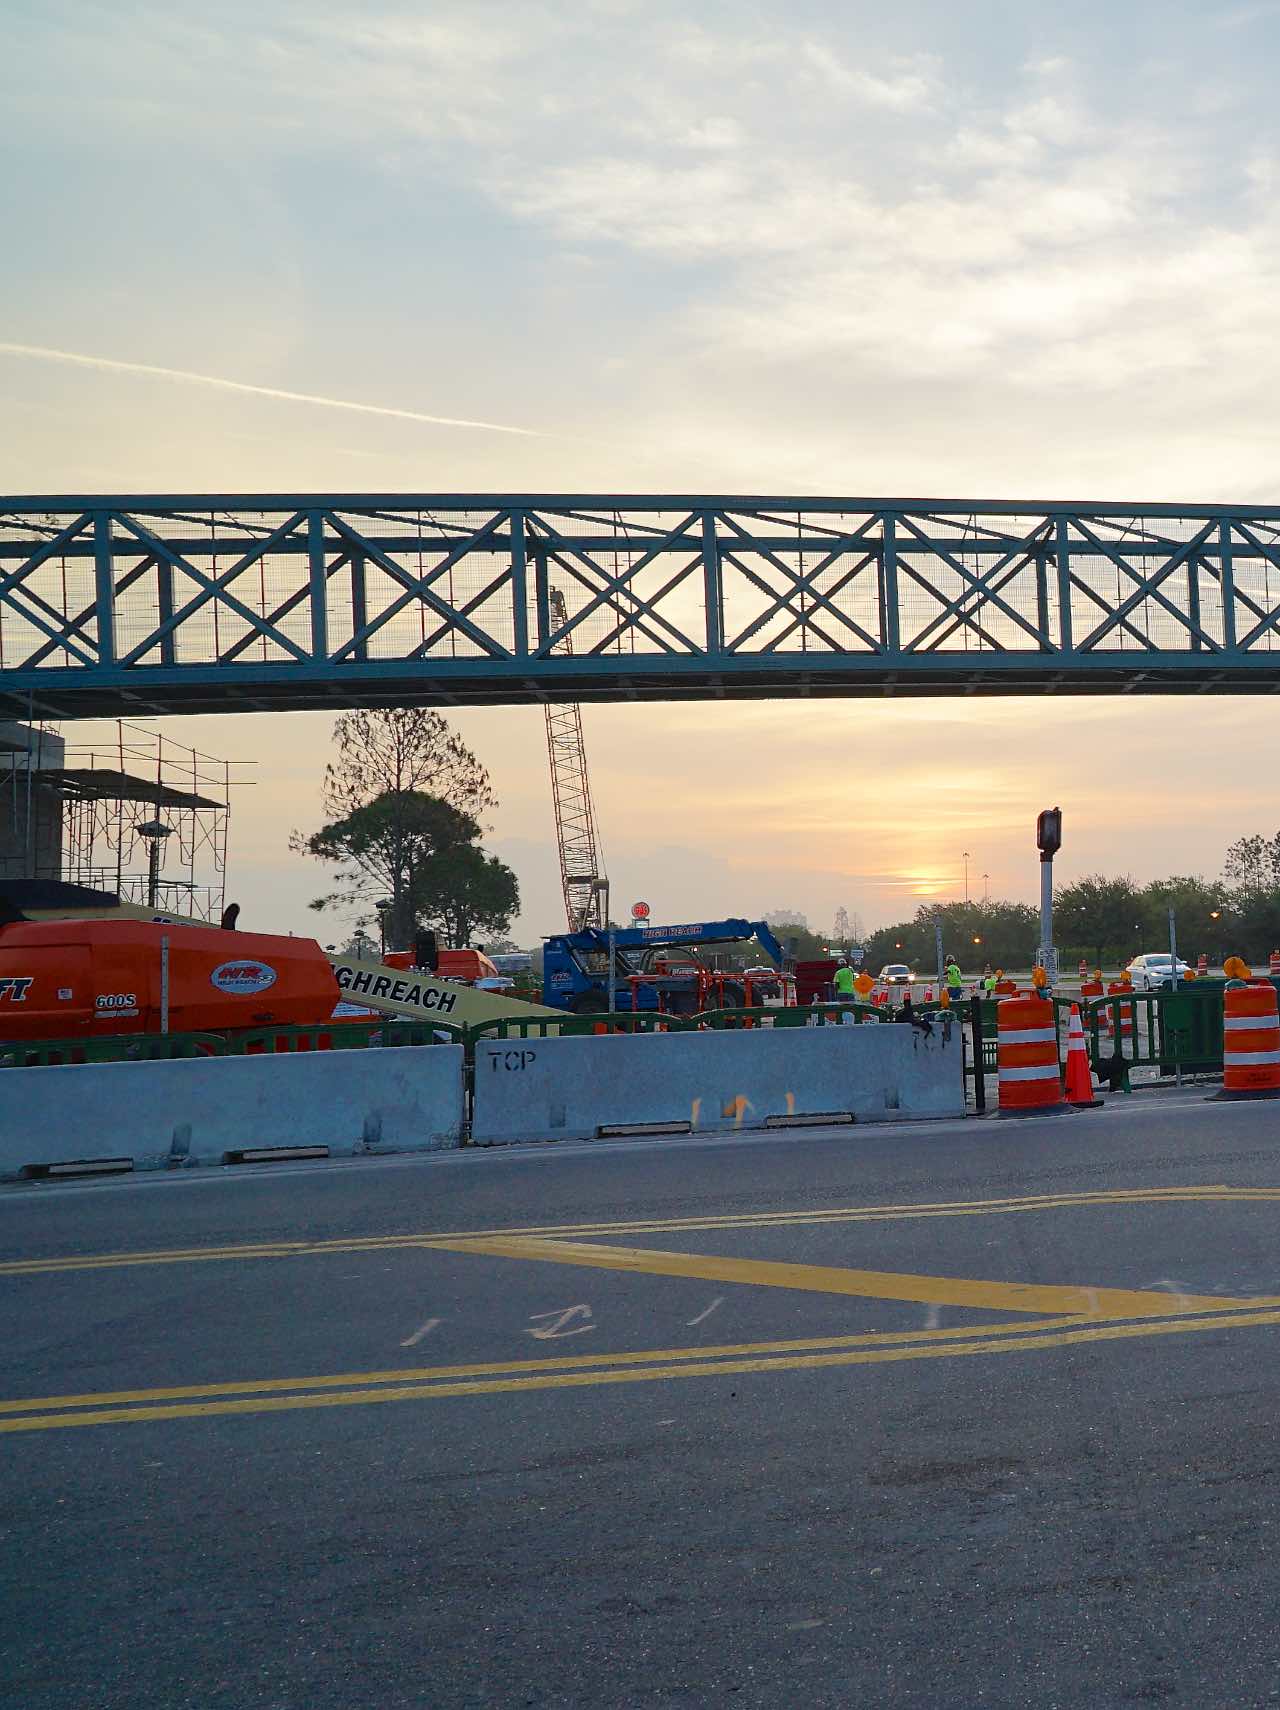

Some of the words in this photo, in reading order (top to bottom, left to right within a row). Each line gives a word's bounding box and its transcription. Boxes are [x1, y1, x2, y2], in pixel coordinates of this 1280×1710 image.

[329, 963, 457, 1013] GHREACH
[96, 993, 137, 1008] 600S
[487, 1050, 537, 1072] TCP
